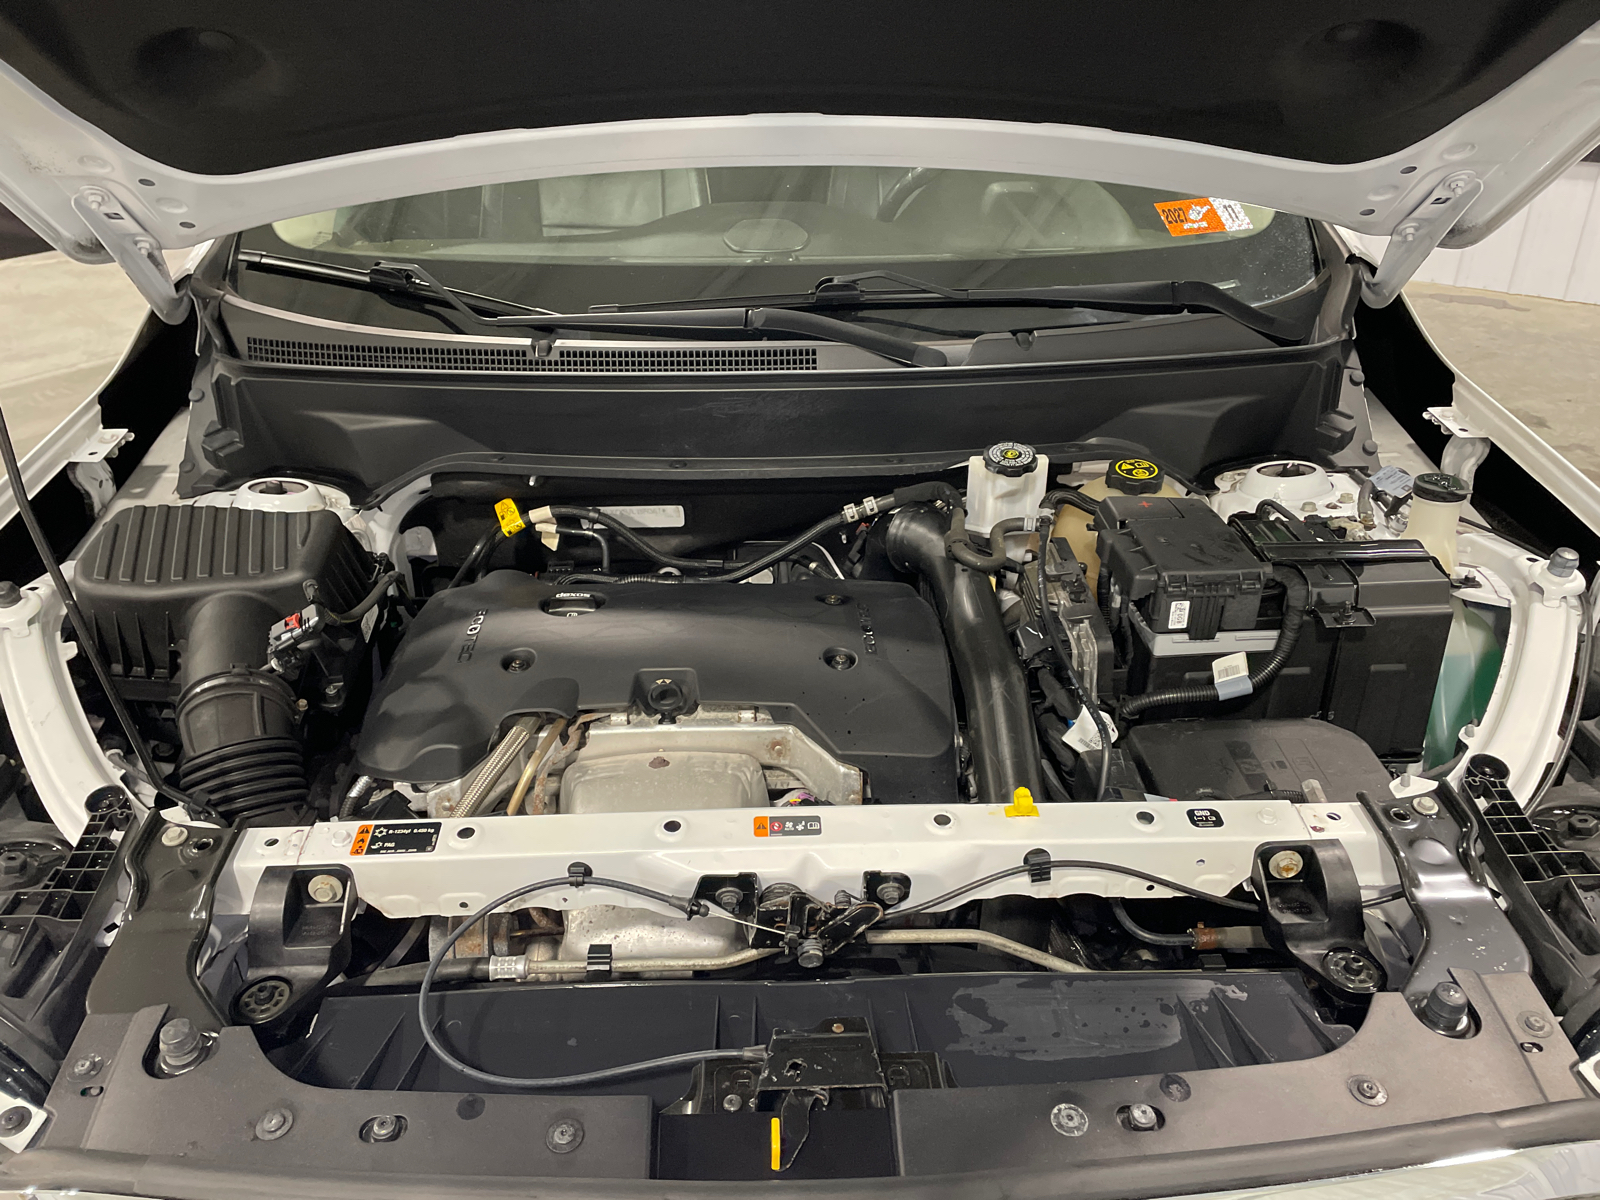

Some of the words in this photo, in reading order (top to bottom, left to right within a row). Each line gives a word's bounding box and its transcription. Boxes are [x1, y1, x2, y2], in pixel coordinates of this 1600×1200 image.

[1161, 206, 1188, 225] 2027
[1223, 204, 1240, 222] 11
[457, 608, 489, 664] ECOTEC
